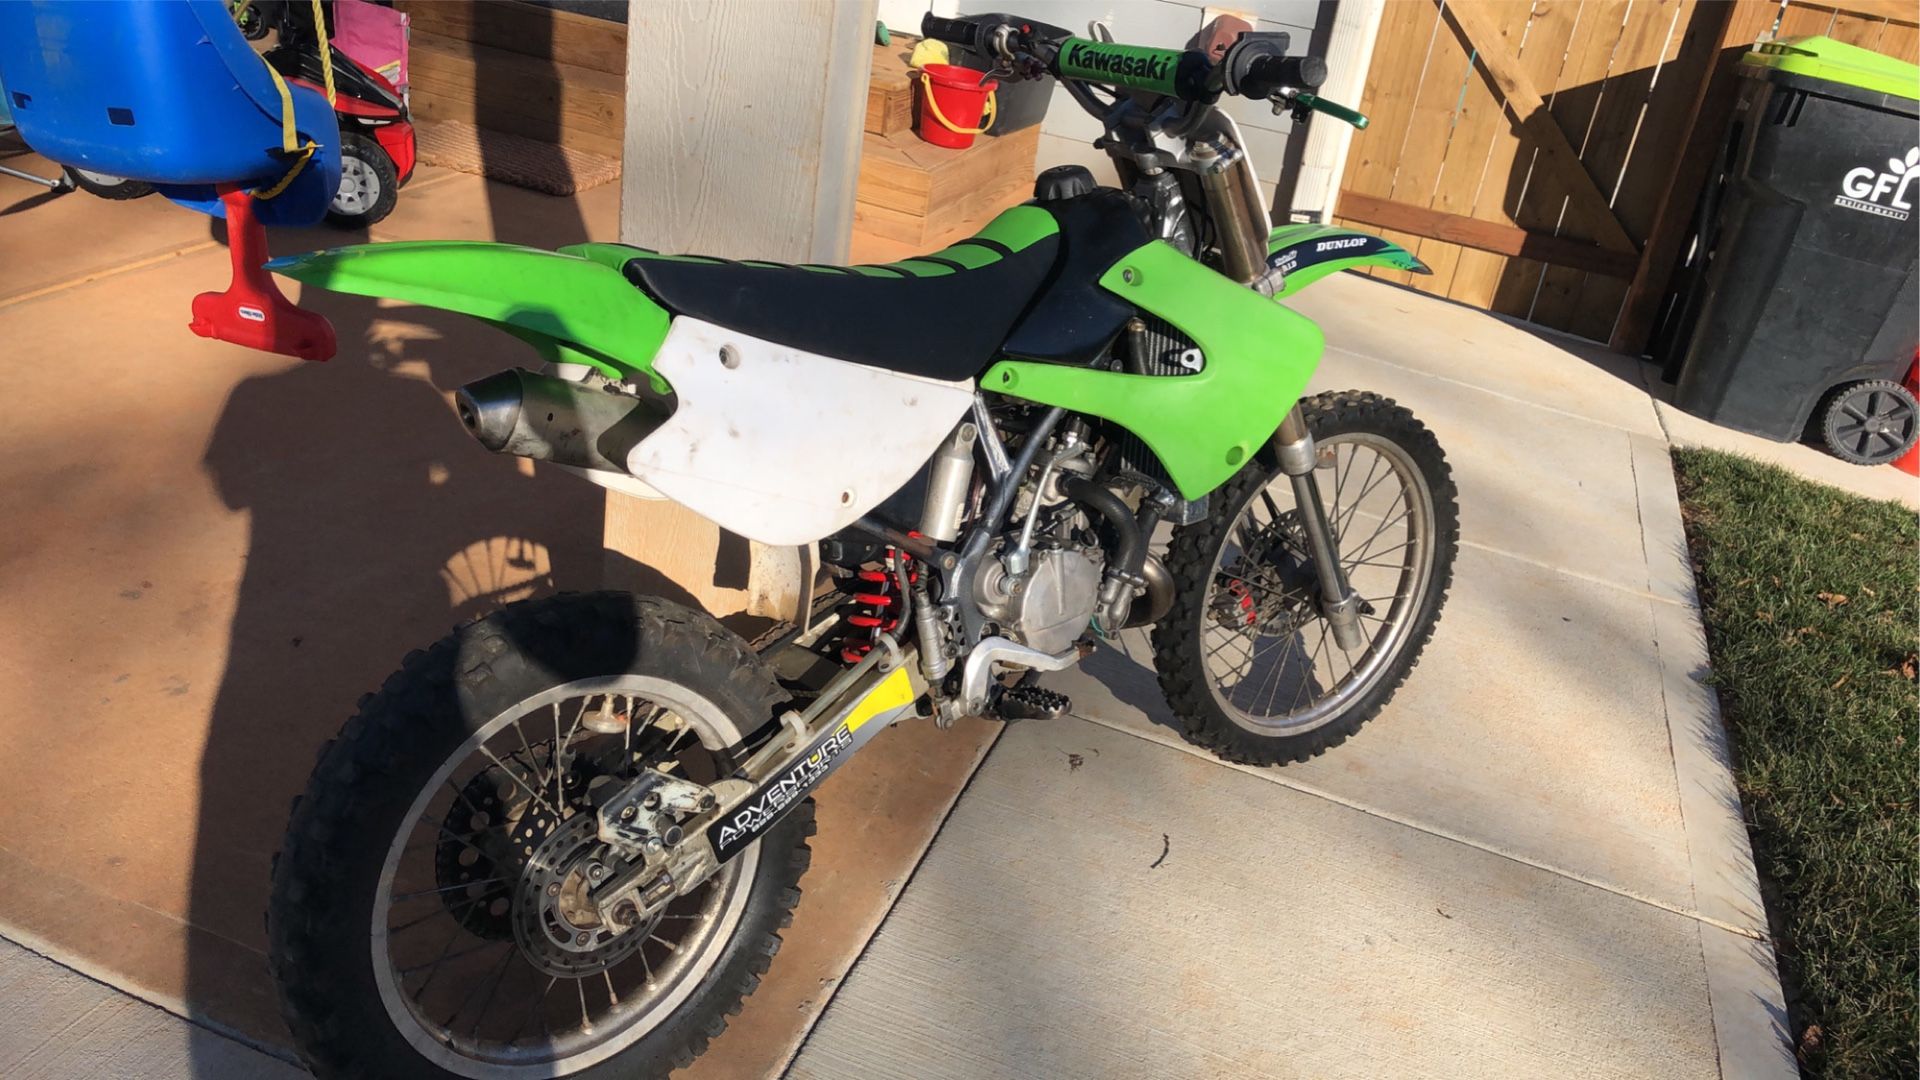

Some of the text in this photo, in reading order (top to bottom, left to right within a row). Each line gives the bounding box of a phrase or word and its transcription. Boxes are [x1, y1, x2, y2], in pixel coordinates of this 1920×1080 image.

[1067, 43, 1172, 80] Kawasaki
[1316, 238, 1367, 252] DUNLOP
[719, 725, 850, 844] ADVENTURE
